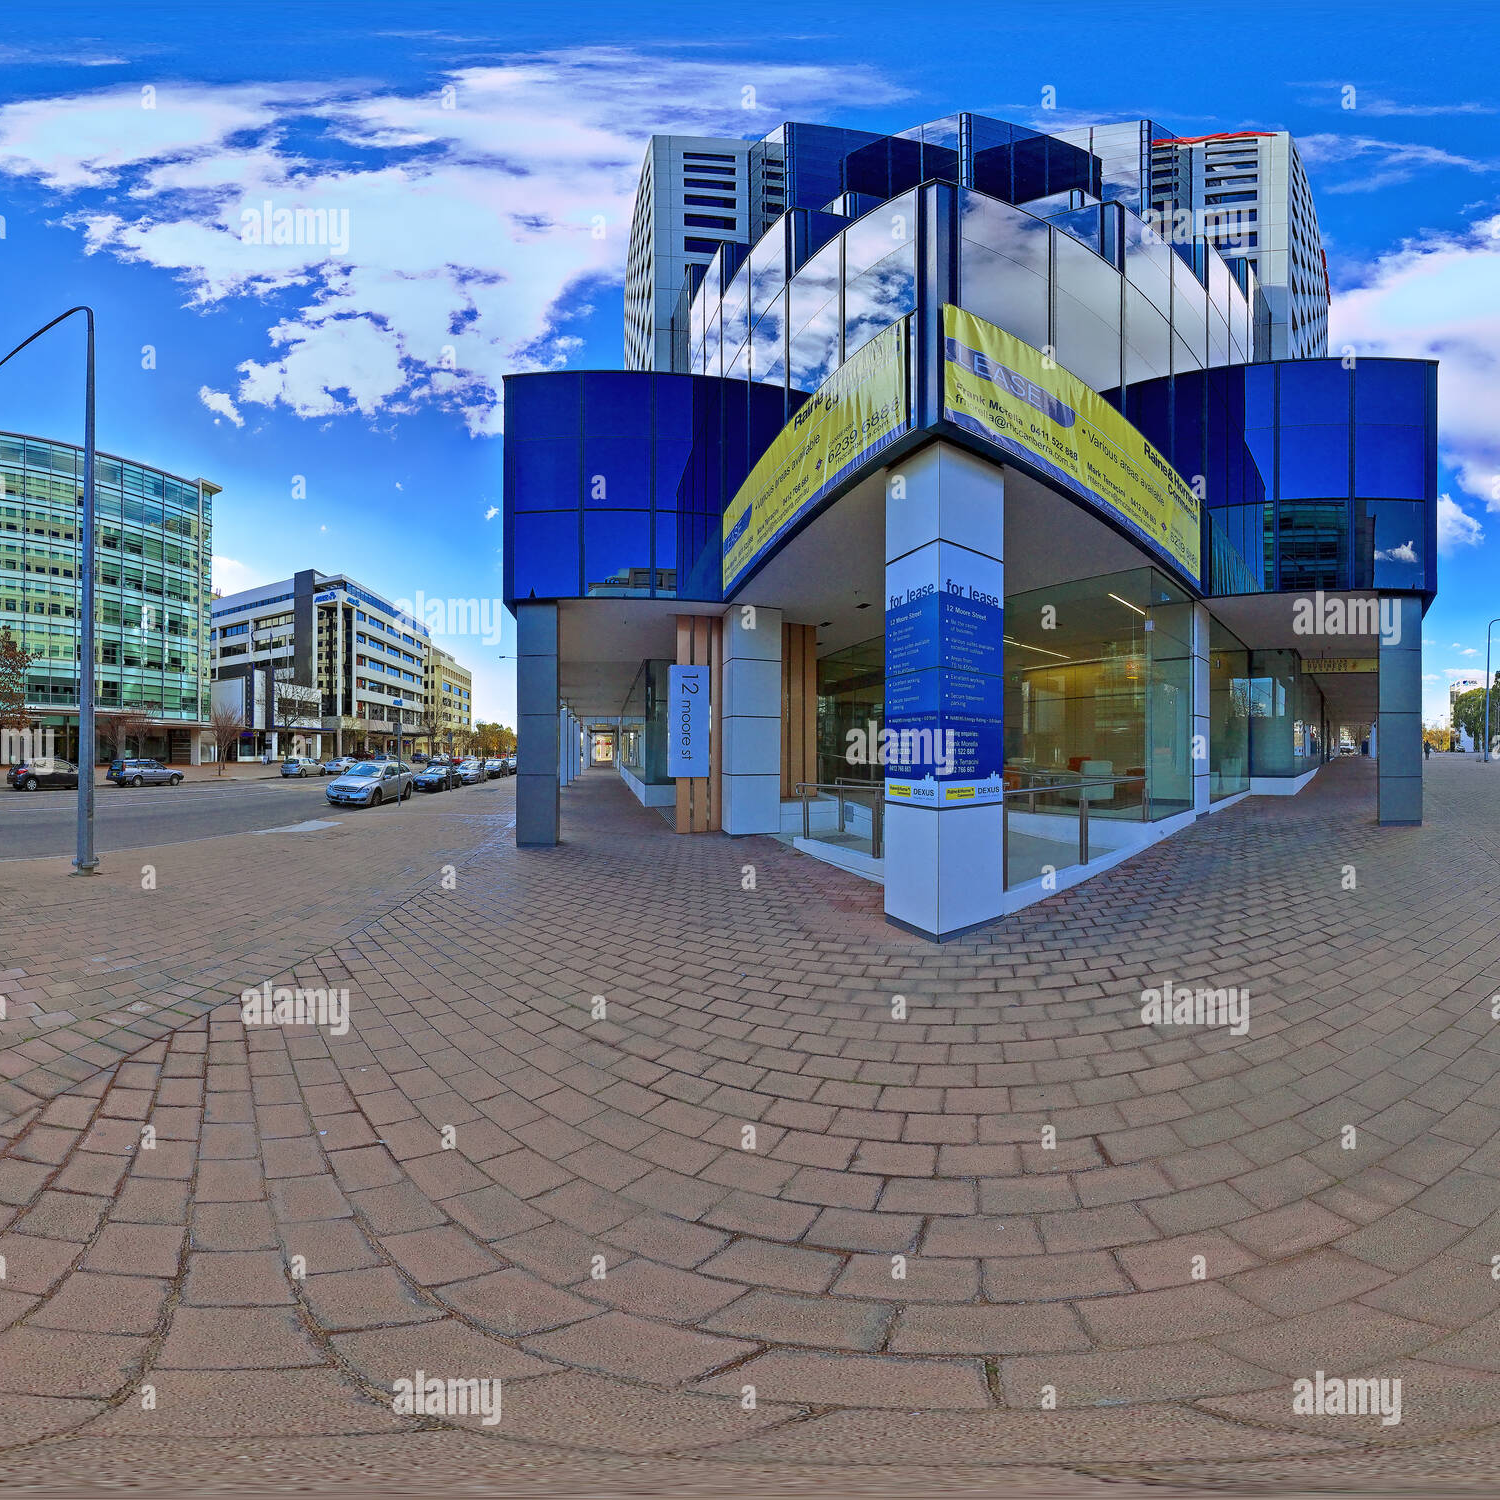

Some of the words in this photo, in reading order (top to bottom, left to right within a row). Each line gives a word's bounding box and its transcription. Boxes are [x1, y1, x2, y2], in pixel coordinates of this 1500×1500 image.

[957, 345, 1044, 408] LEASE
[828, 429, 858, 463] 6239
[1030, 424, 1049, 441] 0411
[1052, 437, 1064, 451] 522
[1087, 462, 1101, 479] Mark
[1088, 429, 1118, 464] Various
[1120, 459, 1139, 483] areas
[1140, 481, 1165, 507] available
[890, 594, 903, 610] for
[906, 583, 934, 603] lease
[946, 578, 964, 597] for
[969, 585, 999, 607] lease
[946, 604, 953, 613] 12
[955, 606, 970, 617] Moore
[972, 611, 987, 621] Street
[682, 674, 699, 694] 12
[682, 700, 691, 746] moore
[682, 750, 693, 760] st
[913, 787, 935, 797] DEXUS
[978, 786, 1000, 794] DEXUS
